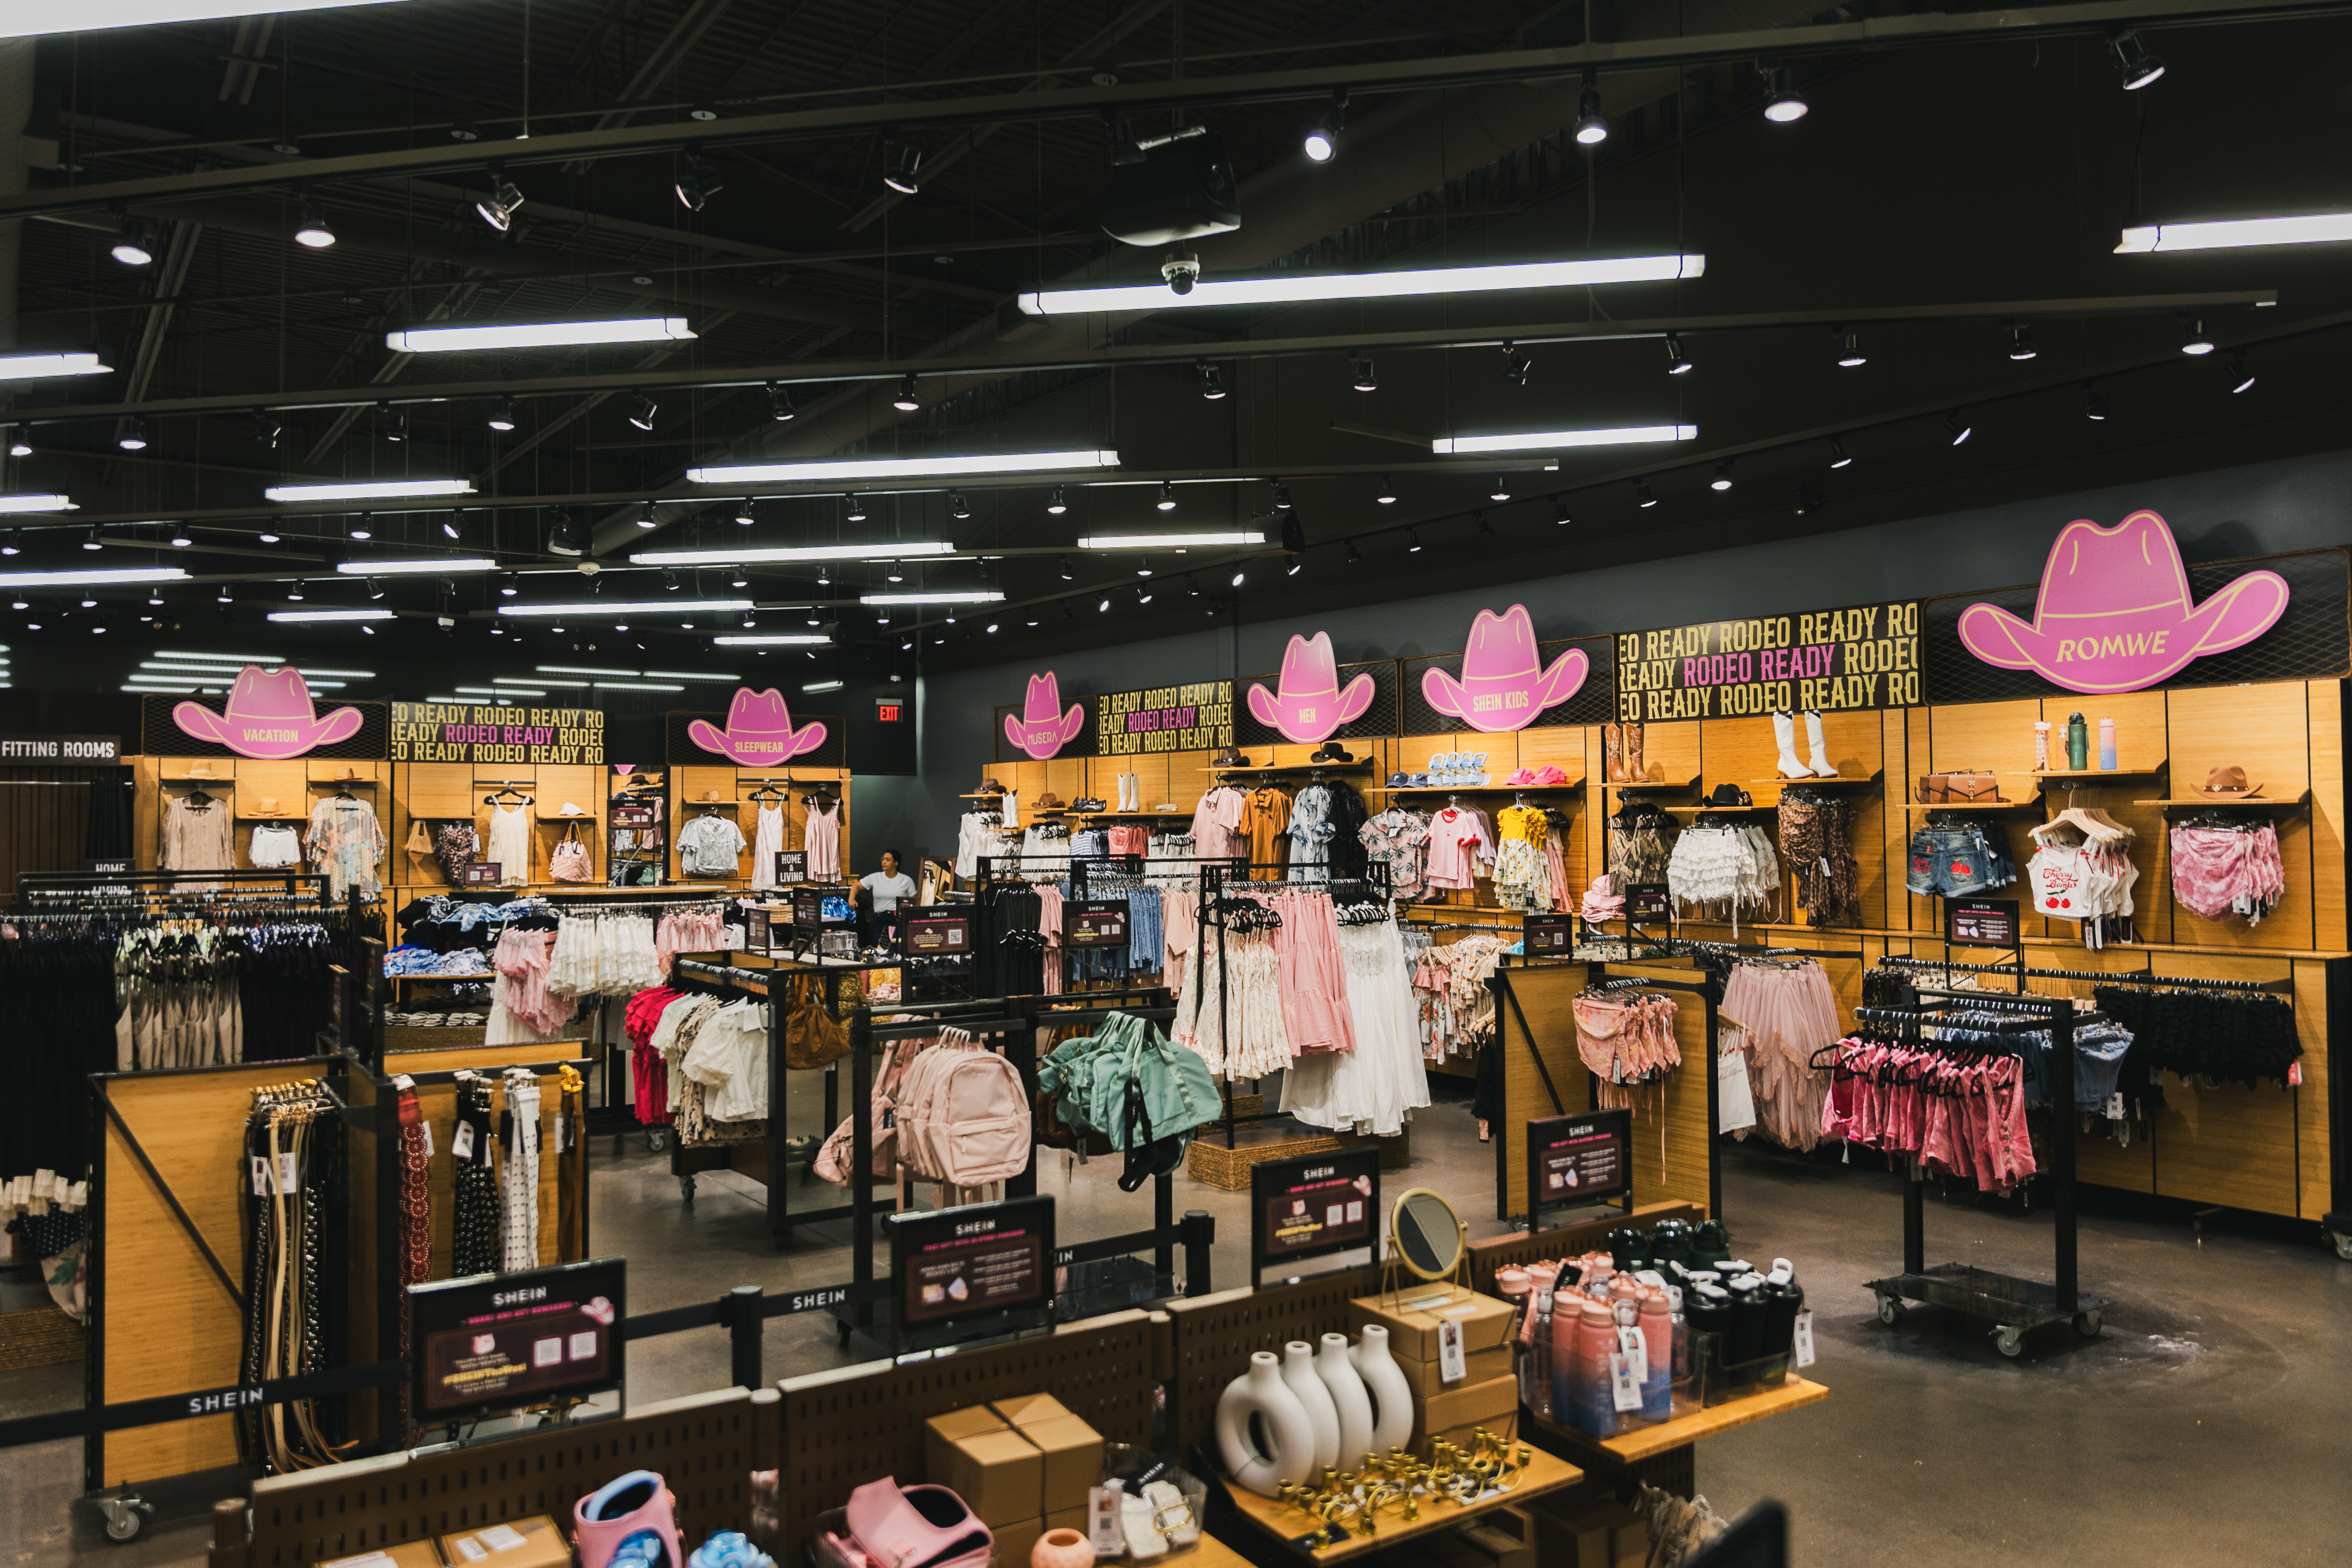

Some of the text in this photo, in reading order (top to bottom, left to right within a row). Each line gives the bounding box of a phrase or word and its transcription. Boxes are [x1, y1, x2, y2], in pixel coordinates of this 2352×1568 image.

[1646, 625, 1712, 660] READY
[1719, 617, 1790, 653] RODEO
[1800, 607, 1878, 645] READY
[1887, 603, 1917, 637] RO
[2055, 630, 2170, 662] ROMWE
[1683, 653, 1751, 687] RODEO
[1761, 644, 1836, 681] READY
[1112, 691, 1142, 713] READY
[1144, 687, 1176, 710] RODEO
[1180, 683, 1215, 706] READY
[1218, 681, 1231, 703] RO
[1473, 690, 1530, 712] SHEIN KIDS
[1647, 687, 1712, 719] READY
[1720, 681, 1791, 715] RODEO
[1800, 674, 1878, 710] READY
[1887, 671, 1919, 705] RO
[415, 704, 468, 724] READY
[474, 706, 525, 725] RODEO
[531, 708, 580, 727] READY
[585, 711, 603, 728] RO
[880, 706, 898, 721] EXIT
[1128, 710, 1159, 732] RODEO
[1163, 706, 1196, 729] READY
[1299, 708, 1316, 724] MEN
[243, 729, 298, 743] VACATION
[446, 724, 498, 743] RODEO
[504, 726, 554, 745] READY
[1027, 730, 1058, 745] MUSERA
[1112, 733, 1141, 754] READY
[1144, 730, 1176, 752] RODEO
[1180, 727, 1214, 749] READY
[1218, 726, 1232, 747] RO
[1, 741, 115, 758] FITTING ROOMS
[414, 742, 468, 761] READY
[474, 743, 524, 762] RODEO
[530, 745, 580, 764] READY
[585, 747, 603, 764] RO
[735, 741, 784, 753] SLEEPWEAR
[96, 863, 126, 873] HOME
[781, 854, 802, 864] HOME
[780, 872, 803, 882] LIVING
[2043, 867, 2078, 882] Cherry
[2046, 879, 2077, 890] Bomb
[1569, 1124, 1594, 1137] SHEIN
[1303, 1166, 1334, 1181] SHEIN
[955, 1219, 995, 1237] SHEIN
[492, 1286, 546, 1308] SHEIN
[792, 1289, 845, 1311] SHEIN
[189, 1388, 264, 1414] SHEIN
